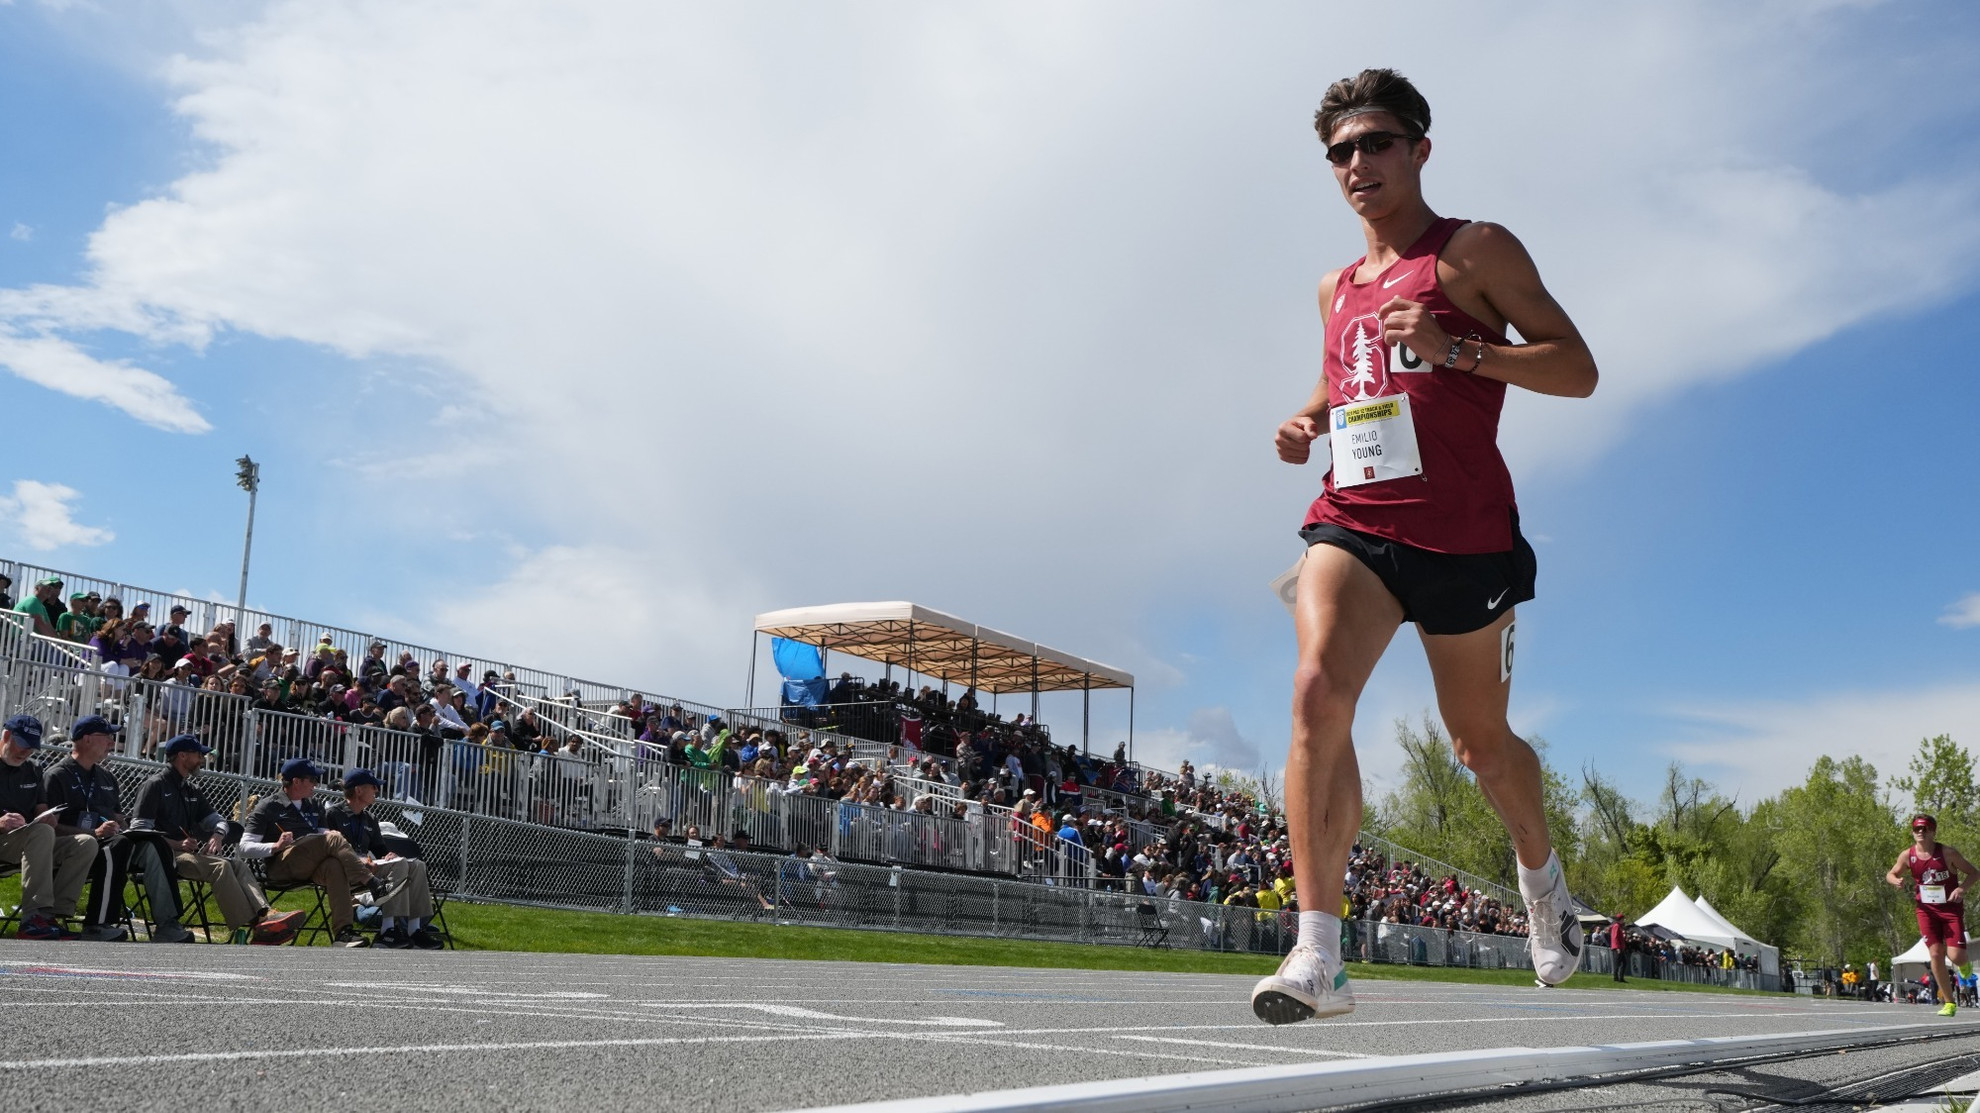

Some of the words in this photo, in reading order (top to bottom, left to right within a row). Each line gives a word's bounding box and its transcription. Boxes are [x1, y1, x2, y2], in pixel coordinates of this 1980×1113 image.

[1348, 409, 1392, 423] CHAMPIONSHIPS
[1351, 430, 1378, 444] EMILIO
[1351, 444, 1383, 460] YOUNG
[1505, 624, 1515, 674] 6
